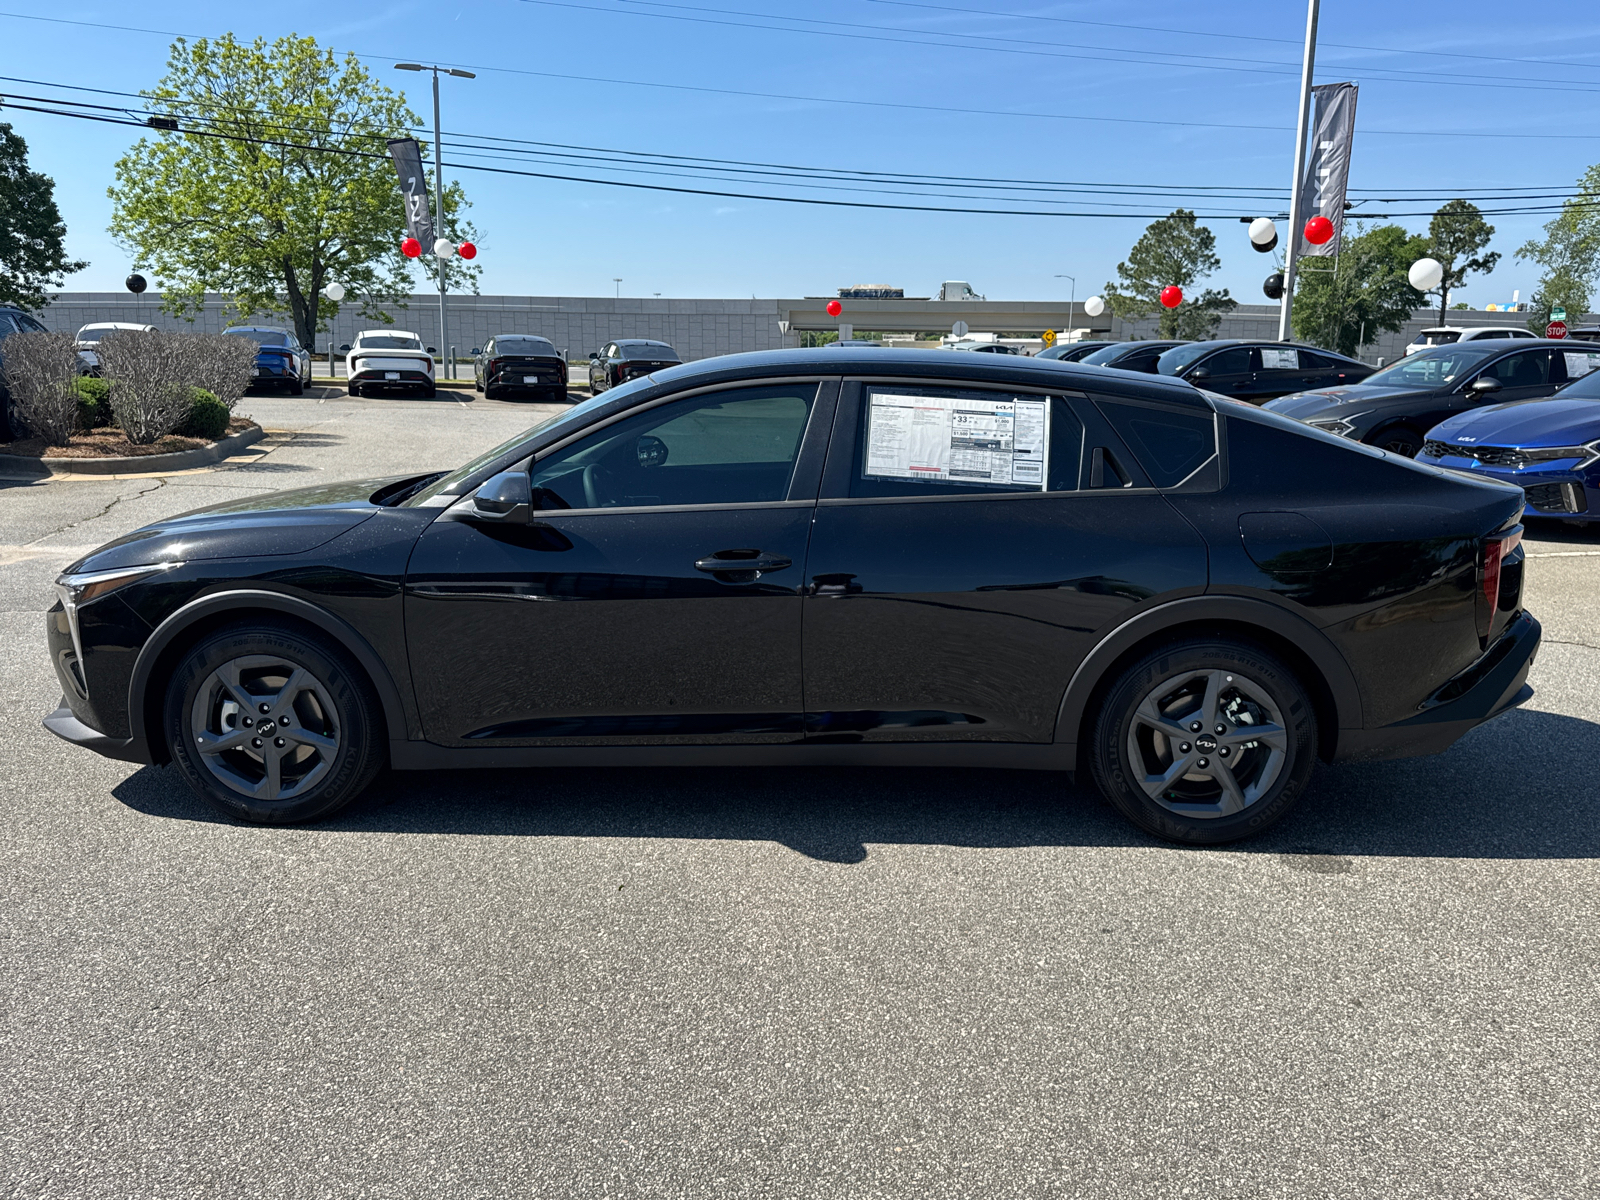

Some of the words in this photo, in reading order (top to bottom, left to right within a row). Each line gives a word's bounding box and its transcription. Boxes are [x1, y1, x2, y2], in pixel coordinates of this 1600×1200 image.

[1547, 328, 1566, 336] STOP
[324, 747, 357, 798] KUMHO
[1249, 779, 1298, 828] KUMHO
